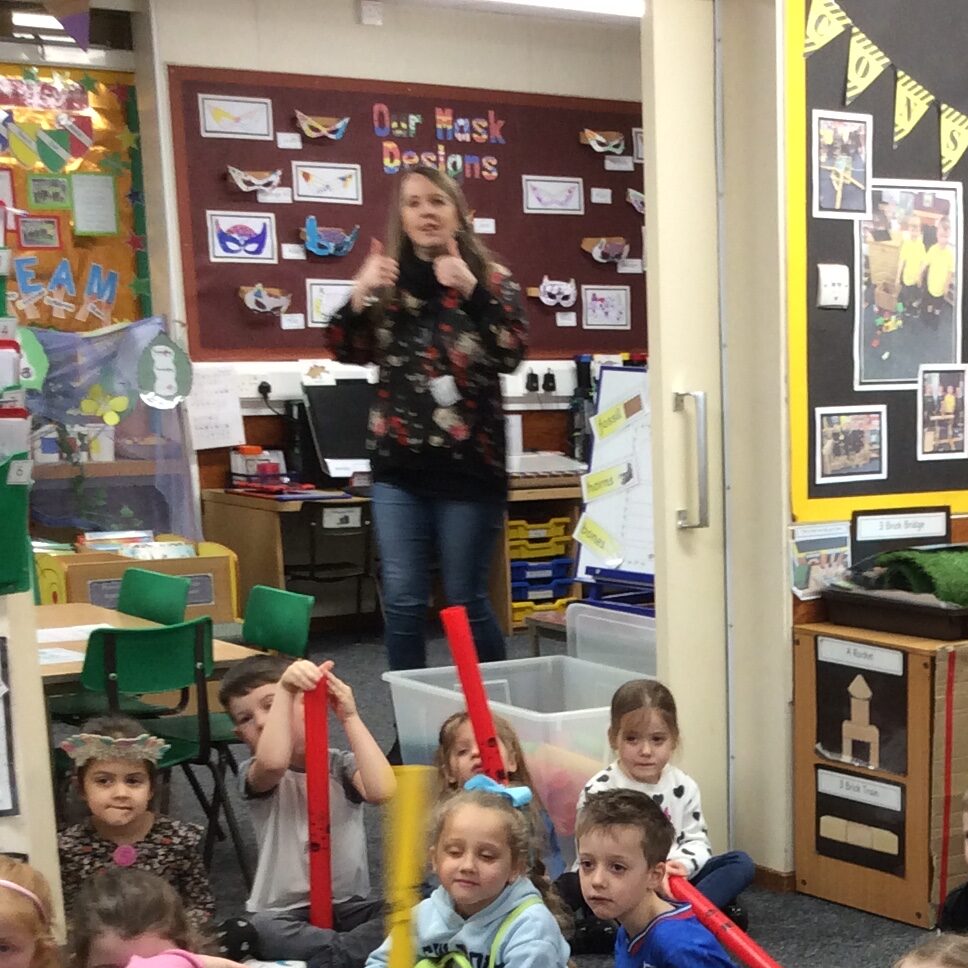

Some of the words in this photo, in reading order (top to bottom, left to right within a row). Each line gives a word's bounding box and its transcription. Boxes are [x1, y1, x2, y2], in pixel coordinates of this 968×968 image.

[373, 103, 423, 138] Our
[434, 106, 506, 144] Mask
[382, 140, 498, 181] Designs
